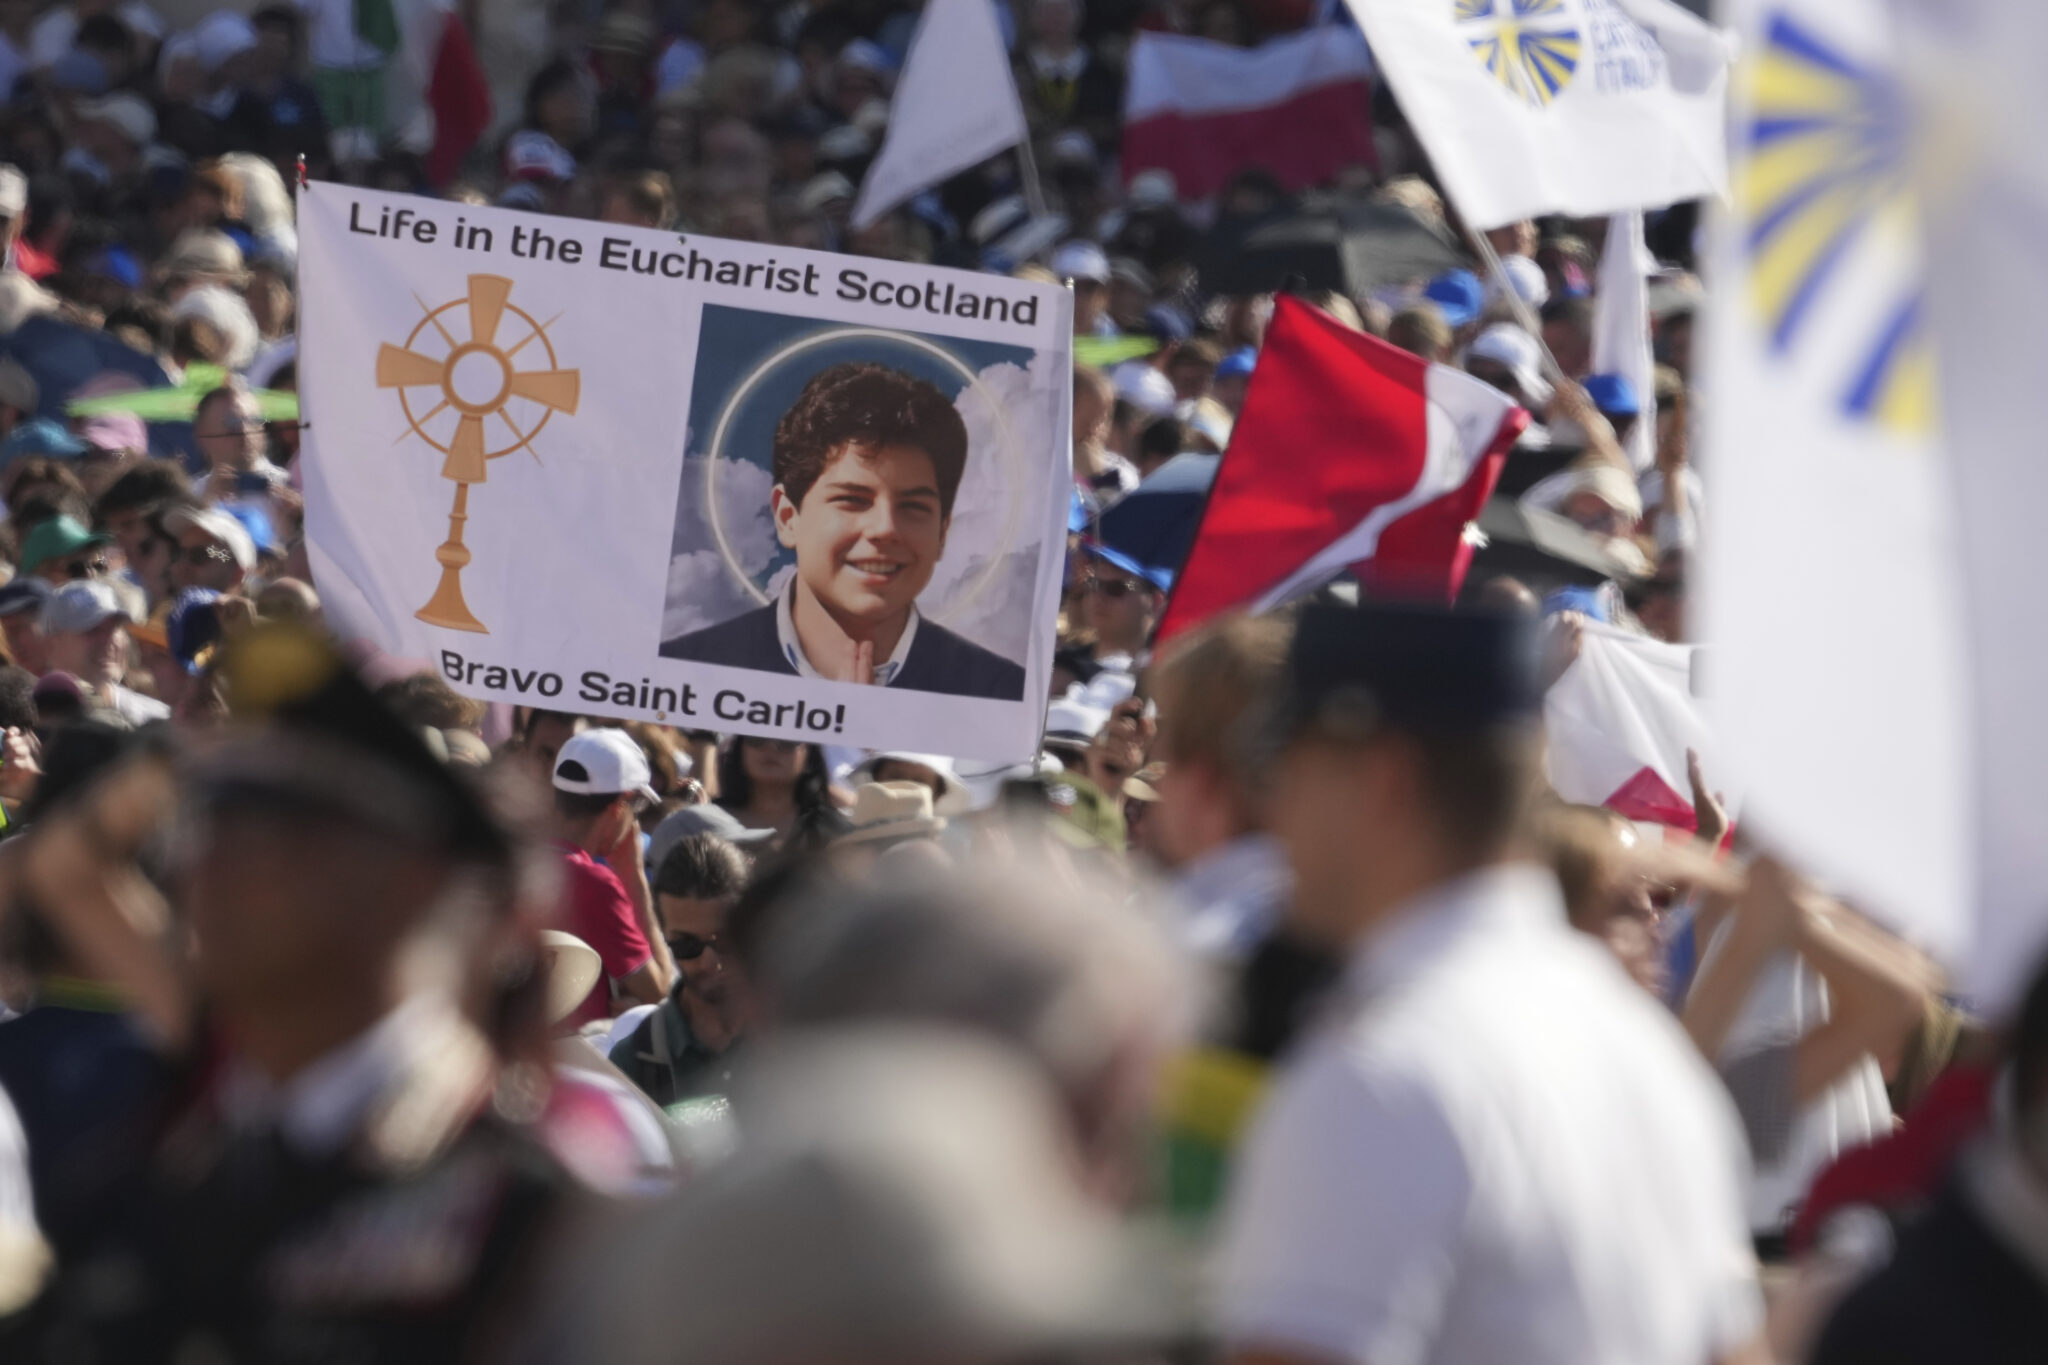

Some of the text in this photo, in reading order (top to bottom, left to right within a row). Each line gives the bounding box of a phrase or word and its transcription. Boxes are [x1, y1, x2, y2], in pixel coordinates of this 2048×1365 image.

[350, 201, 1039, 326] Life in the Eucharist Scotland
[441, 649, 846, 733] Bravo Saint Carlo!
